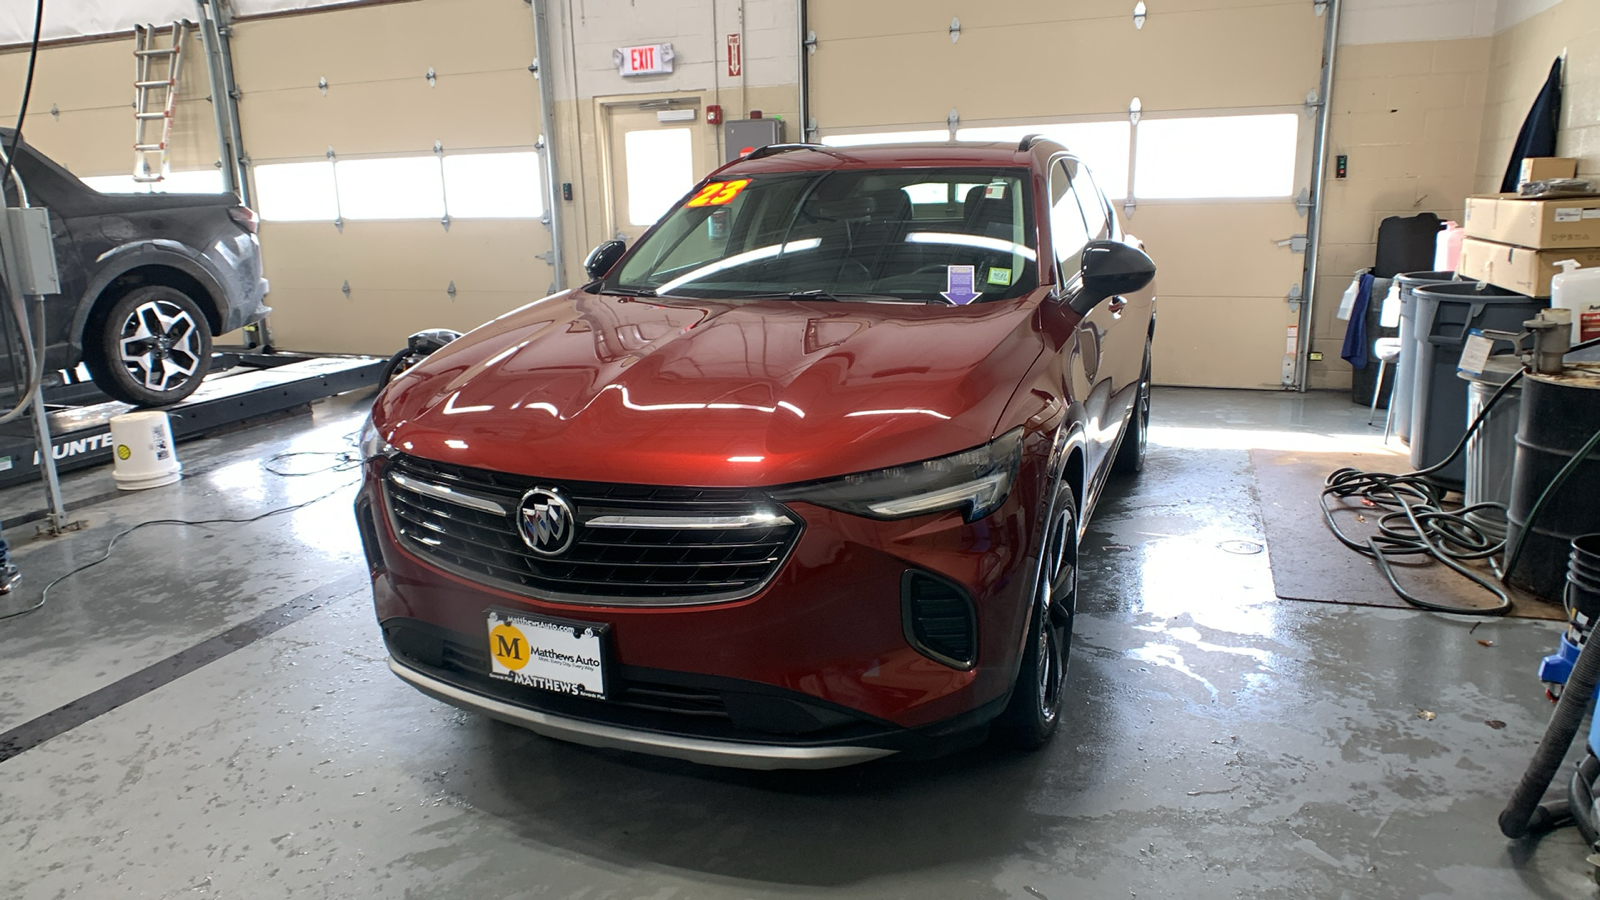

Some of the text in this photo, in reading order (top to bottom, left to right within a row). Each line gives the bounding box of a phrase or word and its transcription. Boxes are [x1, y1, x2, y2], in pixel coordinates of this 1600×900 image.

[631, 47, 654, 71] EXIT
[687, 180, 748, 207] 23
[33, 432, 114, 466] UNTE
[508, 616, 575, 634] MatthewsAuto.com
[495, 634, 523, 660] M
[531, 645, 600, 667] Matthews Auto
[514, 673, 579, 696] MATTHEWS
